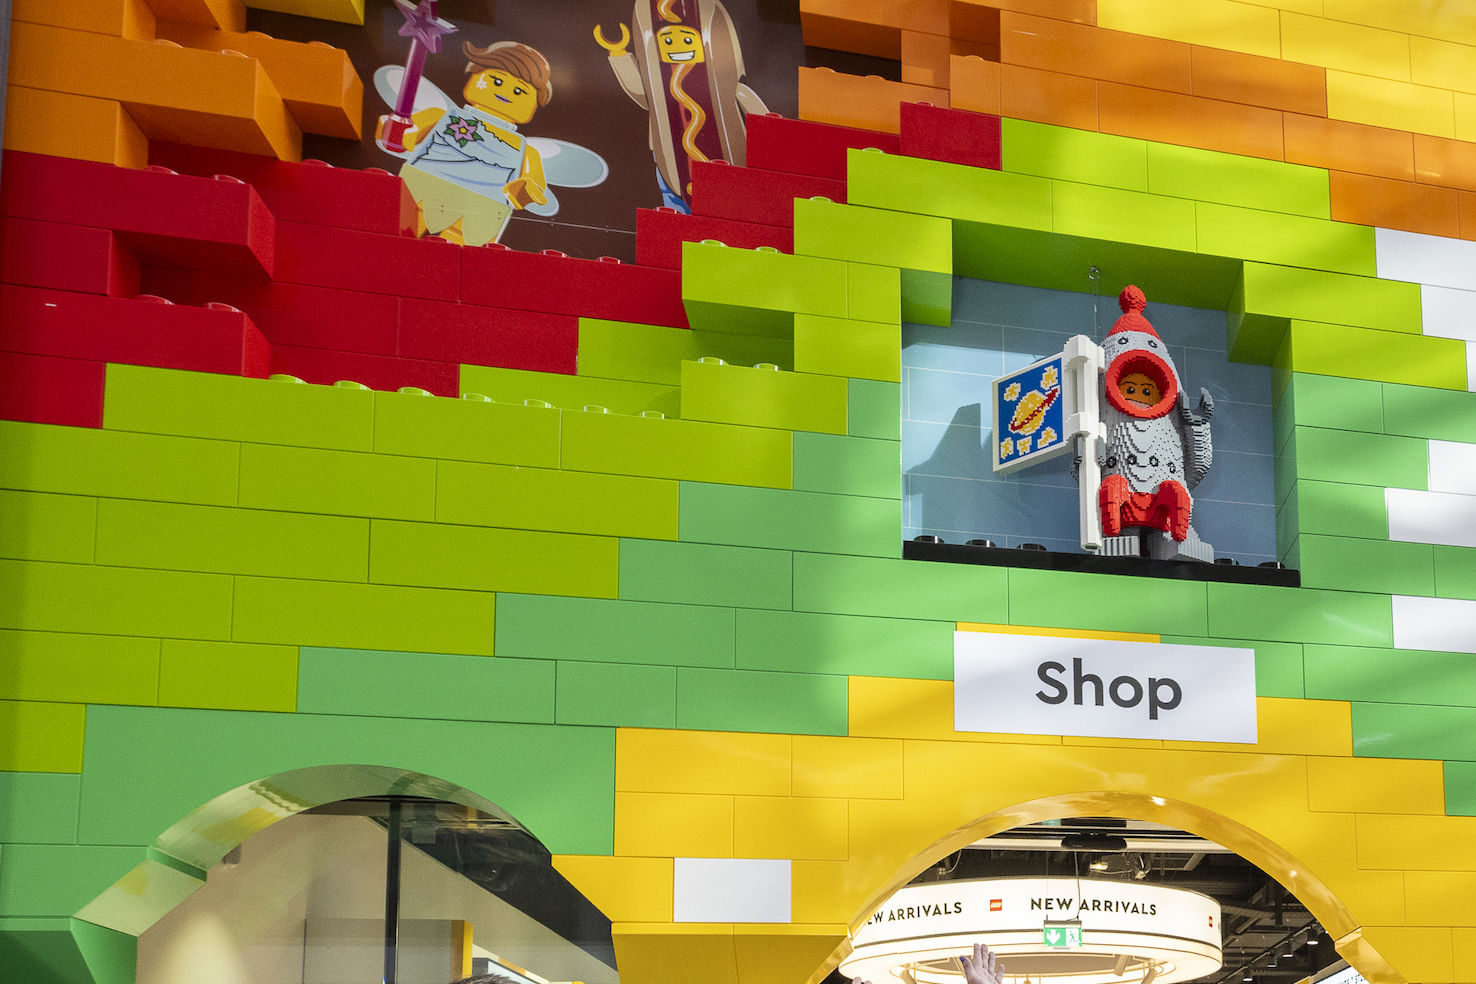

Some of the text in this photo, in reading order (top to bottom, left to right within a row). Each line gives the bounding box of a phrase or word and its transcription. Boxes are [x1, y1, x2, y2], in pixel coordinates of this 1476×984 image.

[1035, 657, 1183, 721] Shop
[888, 901, 963, 922] ARRIVALS
[1030, 898, 1157, 916] NEW ARRIVALS
